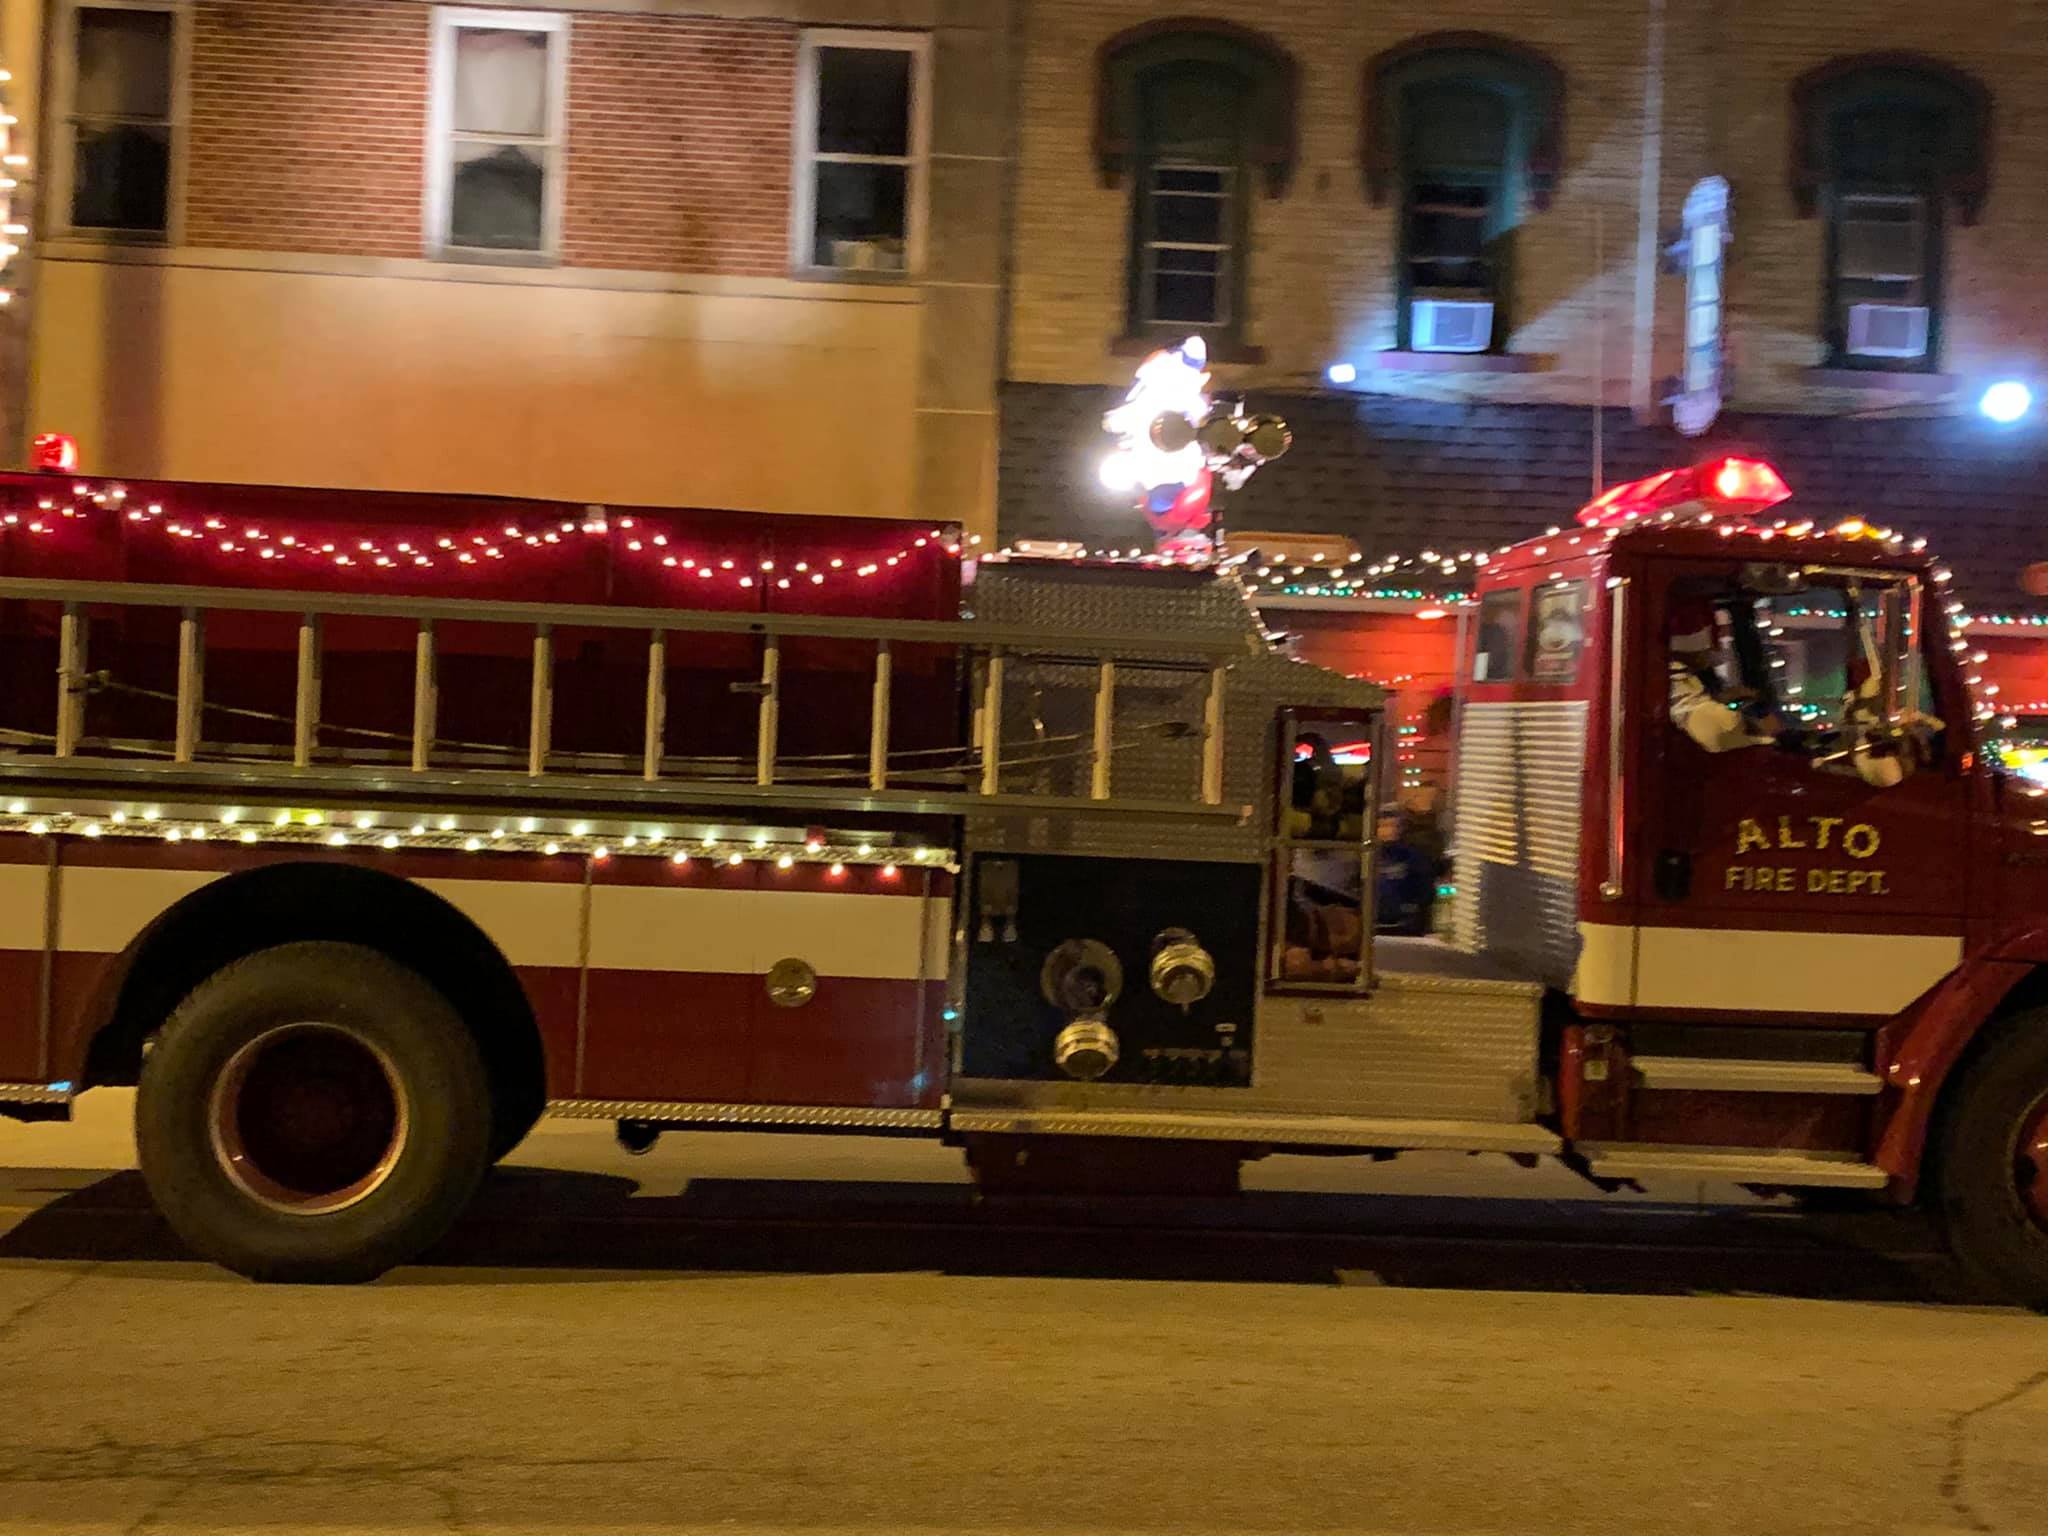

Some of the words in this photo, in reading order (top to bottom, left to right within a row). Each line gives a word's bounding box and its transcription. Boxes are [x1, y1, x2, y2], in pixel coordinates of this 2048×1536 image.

[1735, 816, 1880, 858] ALTO
[1726, 867, 1797, 892] FIRE
[1807, 869, 1889, 895] DEPT.
